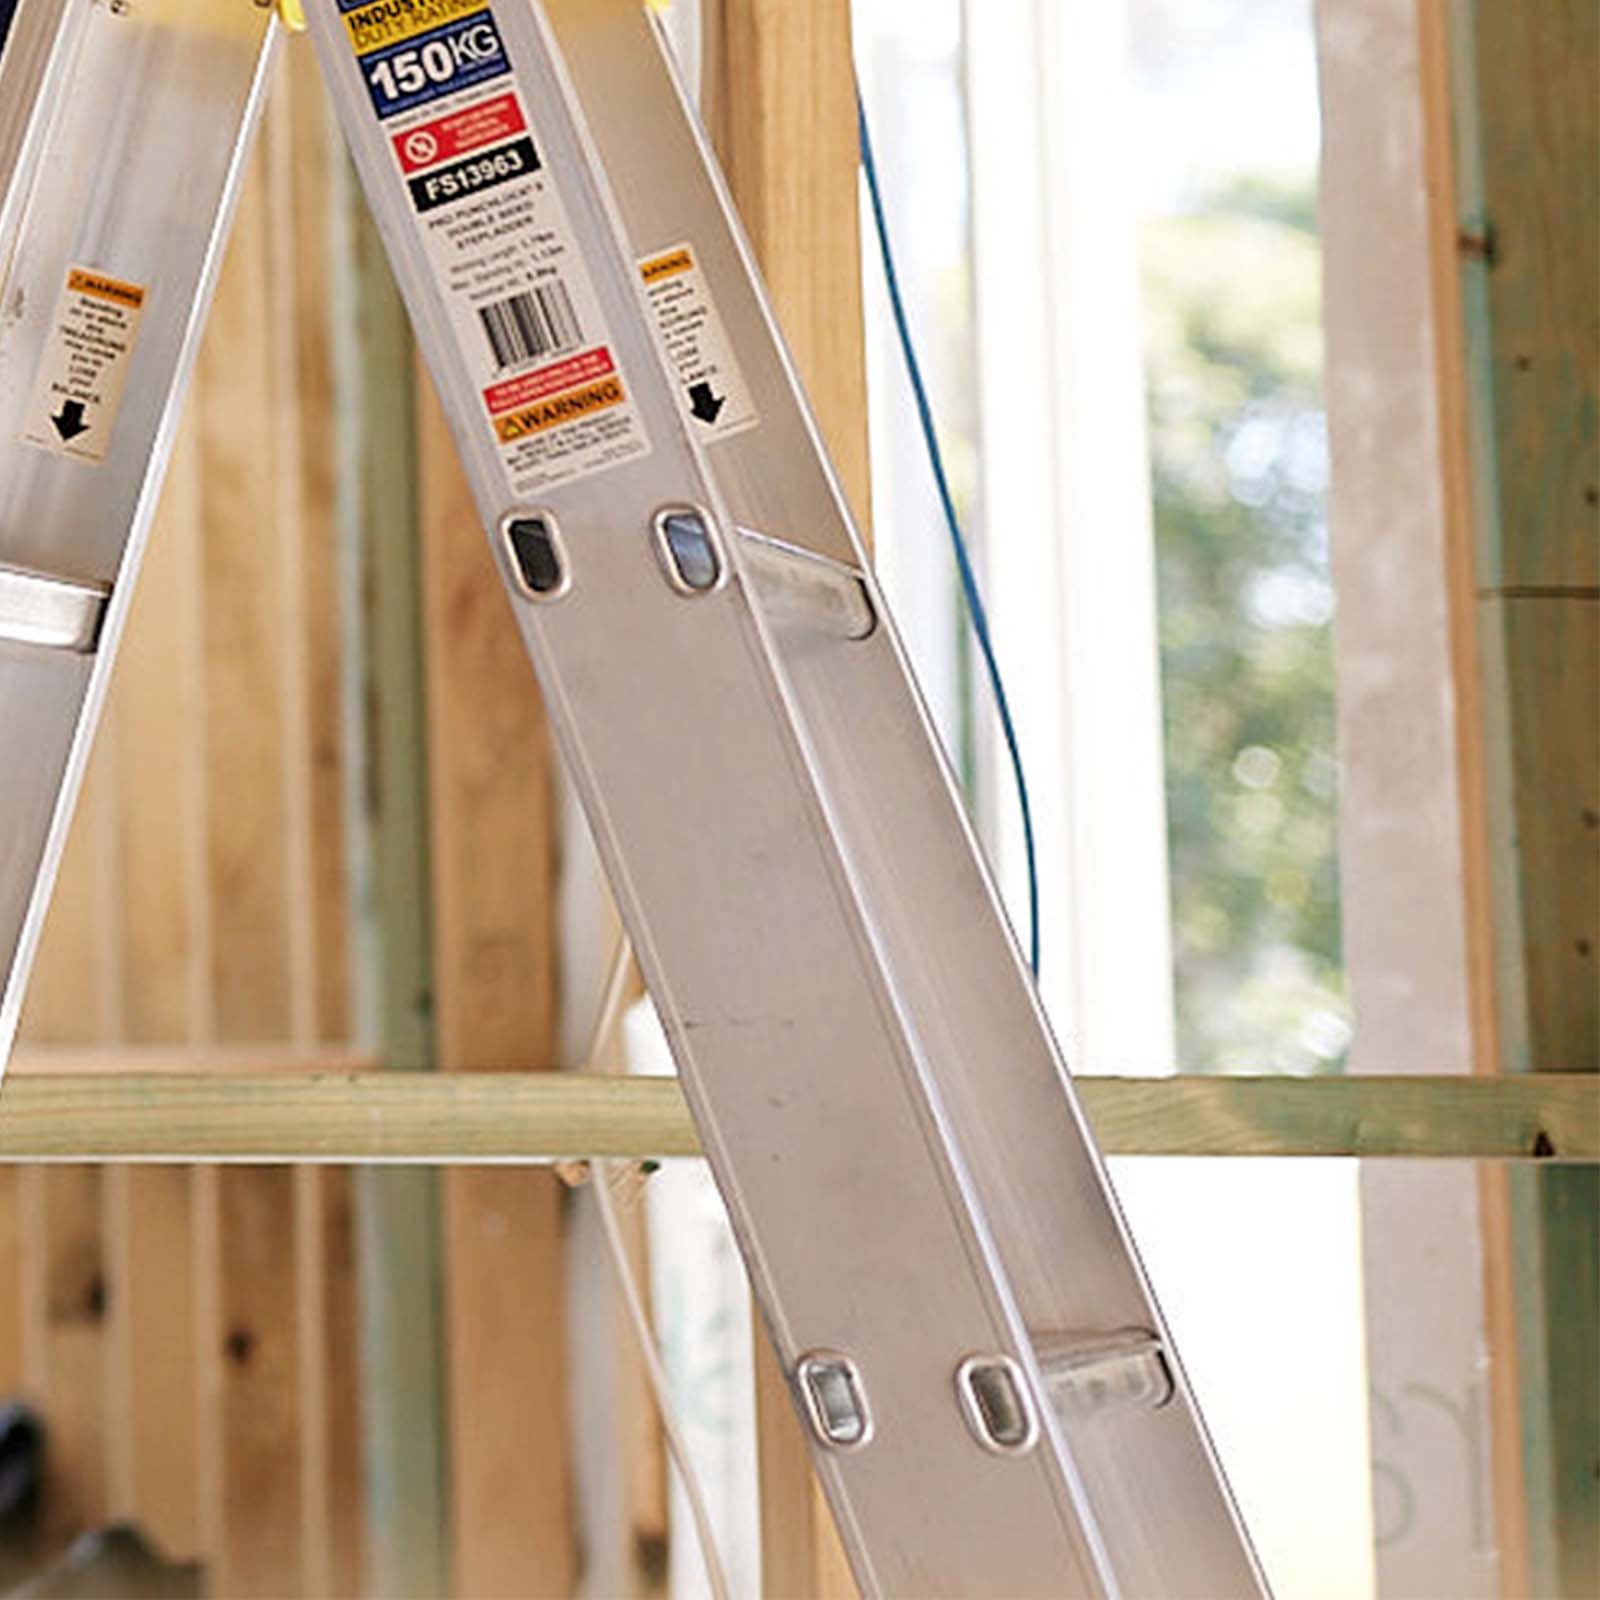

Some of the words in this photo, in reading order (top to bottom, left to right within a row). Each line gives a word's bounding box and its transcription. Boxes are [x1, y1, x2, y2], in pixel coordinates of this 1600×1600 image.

[354, 17, 406, 48] DUTY
[370, 24, 499, 100] 150KG
[425, 149, 524, 201] FS13963
[519, 382, 620, 430] WARNING
